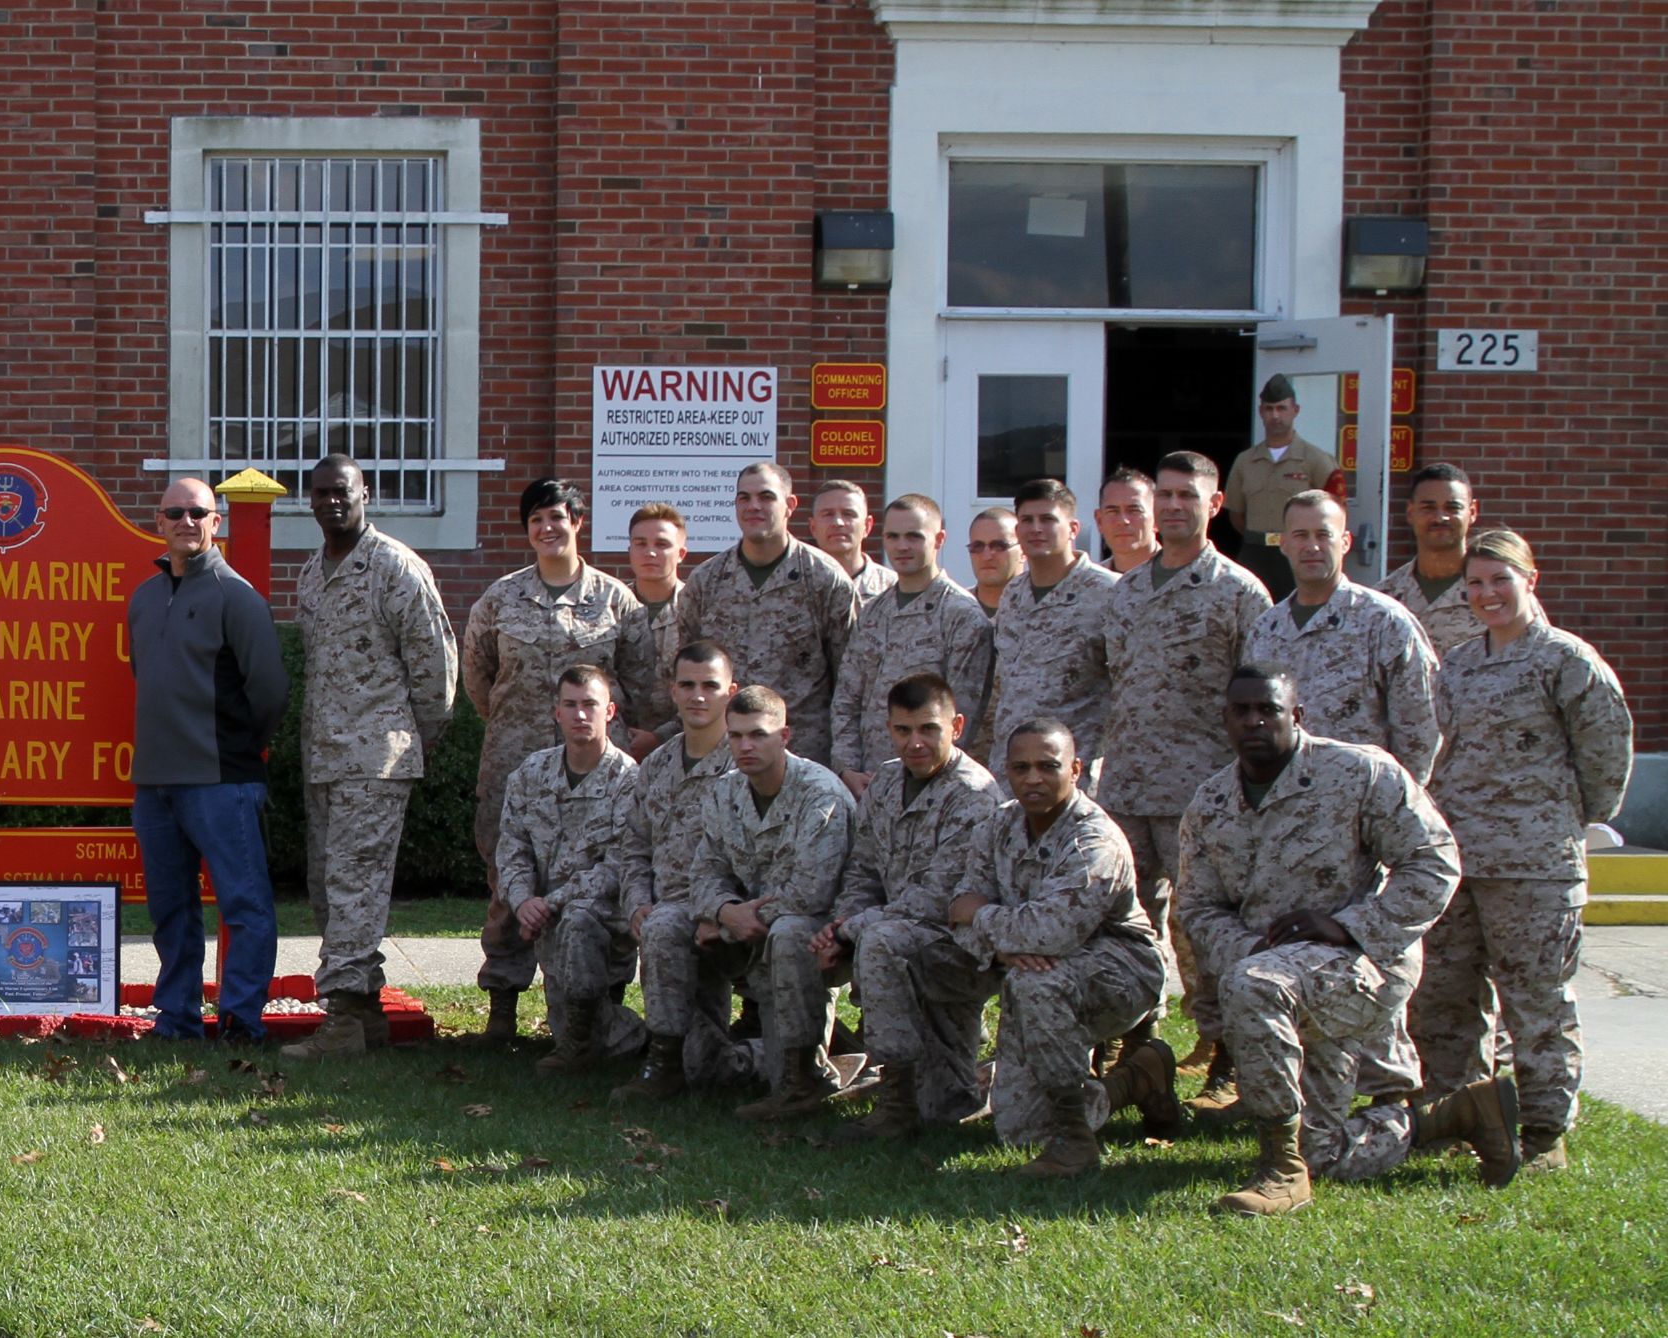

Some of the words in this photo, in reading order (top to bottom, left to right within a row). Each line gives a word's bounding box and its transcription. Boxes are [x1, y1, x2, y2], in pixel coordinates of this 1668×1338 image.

[1456, 333, 1520, 366] 225
[815, 374, 883, 385] COMMANDING
[601, 369, 772, 402] WARNING
[828, 388, 870, 399] OFFICER
[607, 409, 675, 425] RESTRICTED
[677, 409, 739, 425] AREA-KEEP
[741, 410, 764, 425] OUT
[601, 431, 670, 446] AUTHORIZED
[672, 432, 738, 446] PERSONNEL
[741, 432, 770, 447] ONLY
[821, 431, 875, 442] COLONEL
[819, 445, 876, 456] BENEDICT
[597, 470, 651, 478] AUTHORIZED
[652, 470, 680, 478] ENTRY
[681, 470, 701, 478] INTO
[703, 470, 719, 478] THE
[598, 484, 622, 492] AREA
[623, 484, 681, 492] CONSTITUTES
[676, 500, 694, 508] AND
[696, 500, 712, 508] THE
[693, 515, 732, 523] CONTROL
[75, 843, 137, 860] SGTMAJ
